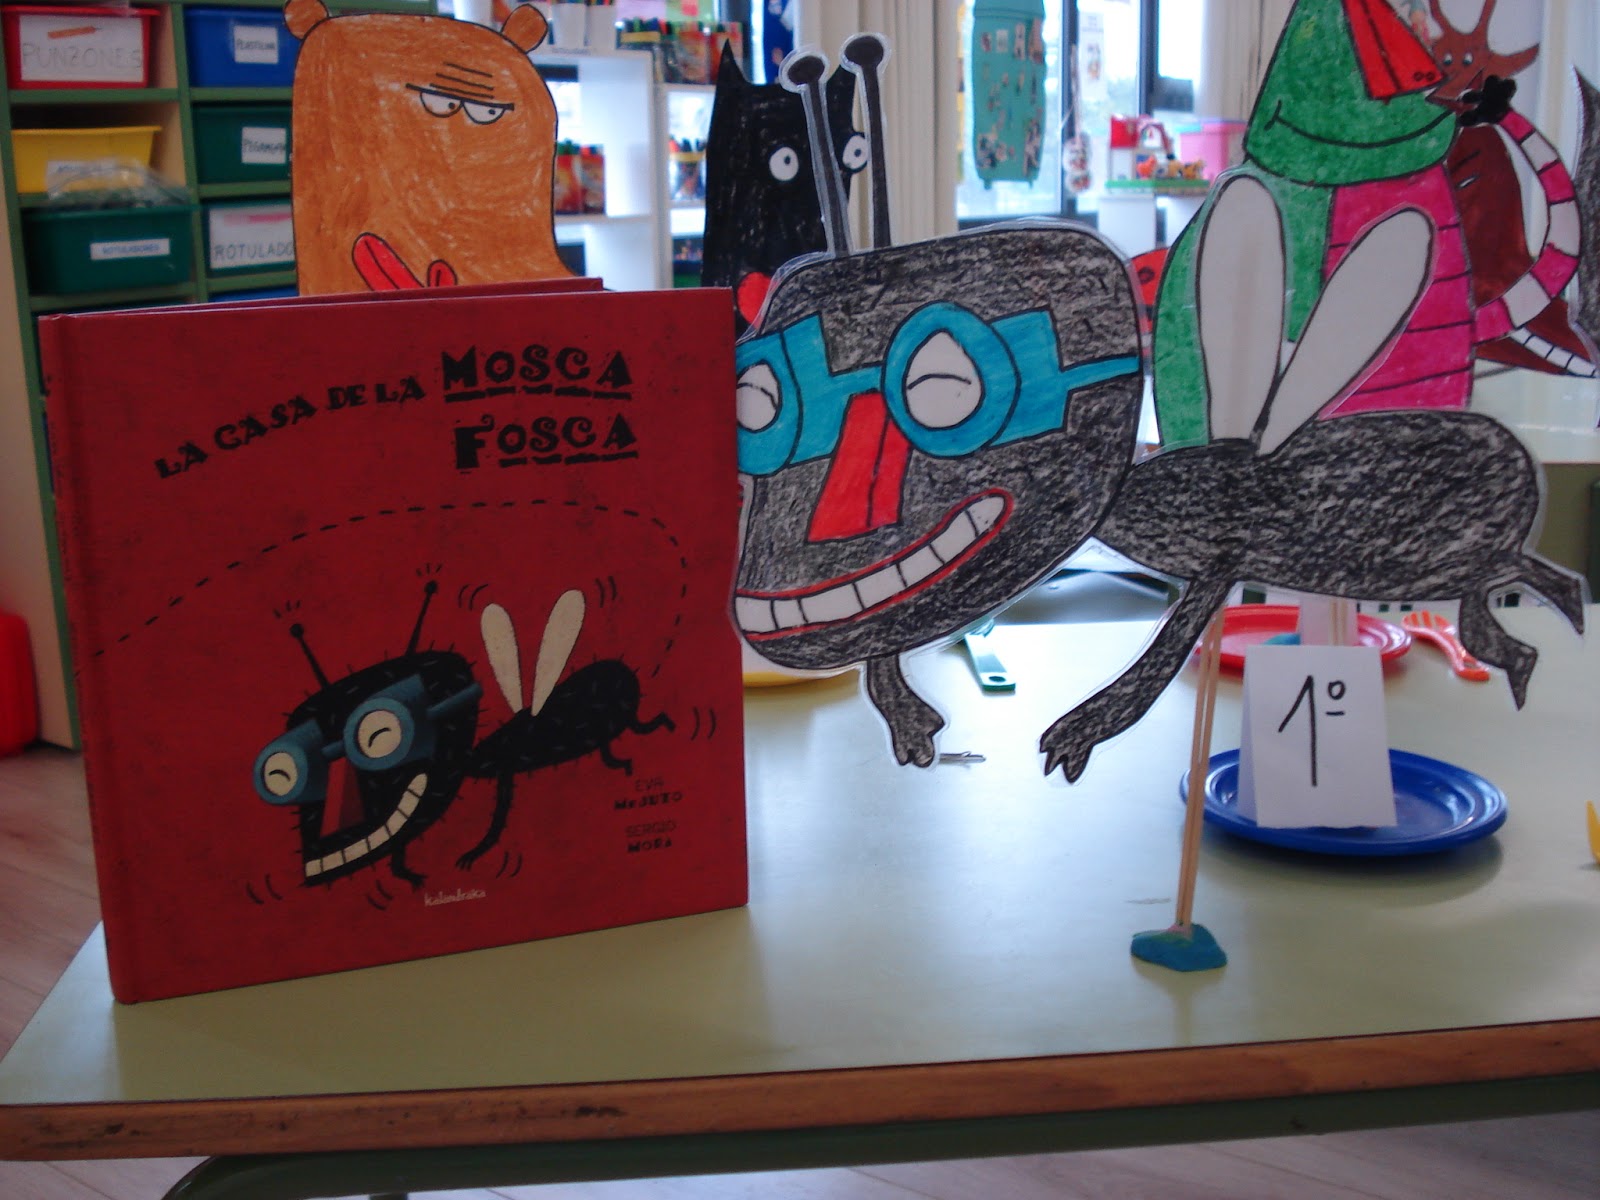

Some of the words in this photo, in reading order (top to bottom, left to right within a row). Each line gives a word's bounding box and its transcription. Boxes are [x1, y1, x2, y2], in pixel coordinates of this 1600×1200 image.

[22, 43, 141, 69] PUNZONES
[154, 442, 208, 479] LA
[214, 396, 317, 450] CASA
[328, 384, 367, 410] DE
[374, 376, 425, 403] LA
[441, 344, 634, 392] MOSCA
[453, 413, 640, 470] FOSCA
